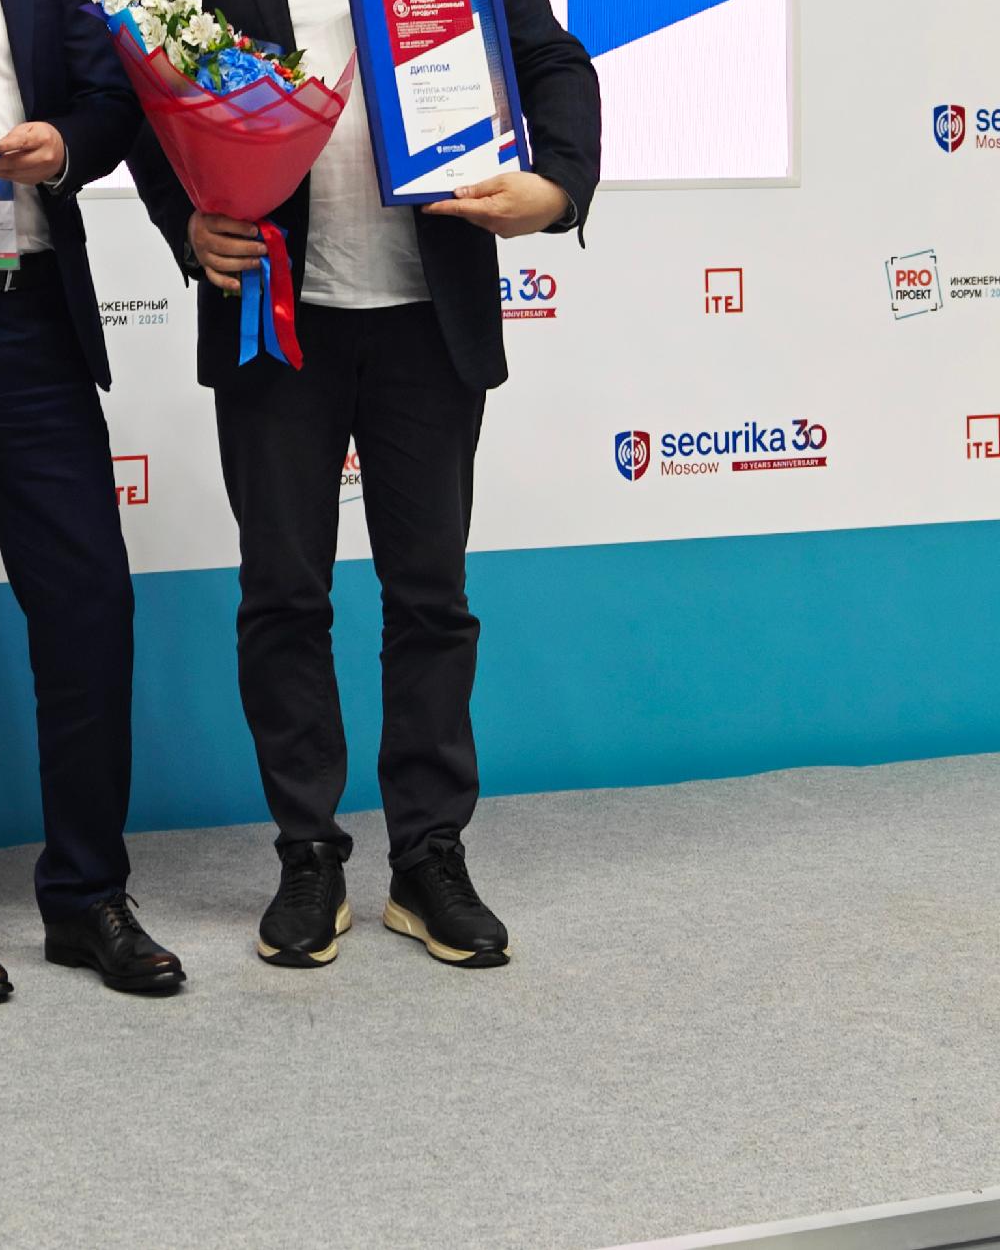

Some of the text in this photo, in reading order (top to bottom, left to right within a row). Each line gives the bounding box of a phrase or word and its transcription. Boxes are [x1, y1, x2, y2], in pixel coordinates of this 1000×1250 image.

[410, 63, 450, 75] ДИПЛОМ
[895, 269, 932, 287] PRO
[950, 275, 1000, 287] ИНЖЕНЕРН
[519, 269, 557, 301] 30
[895, 289, 932, 301] ПРОЕКТ
[950, 289, 982, 299] ФОРУМ
[98, 298, 168, 312] НЖЕНЕРНЫЙ
[705, 296, 734, 313] ITE
[138, 314, 164, 325] 2025
[502, 310, 549, 319] NNIVERSARY
[661, 419, 828, 457] securika 30
[967, 441, 994, 459] ITE
[661, 460, 720, 477] Moscow
[750, 461, 772, 470] YEARS
[772, 459, 819, 469] ANNIVERSARY
